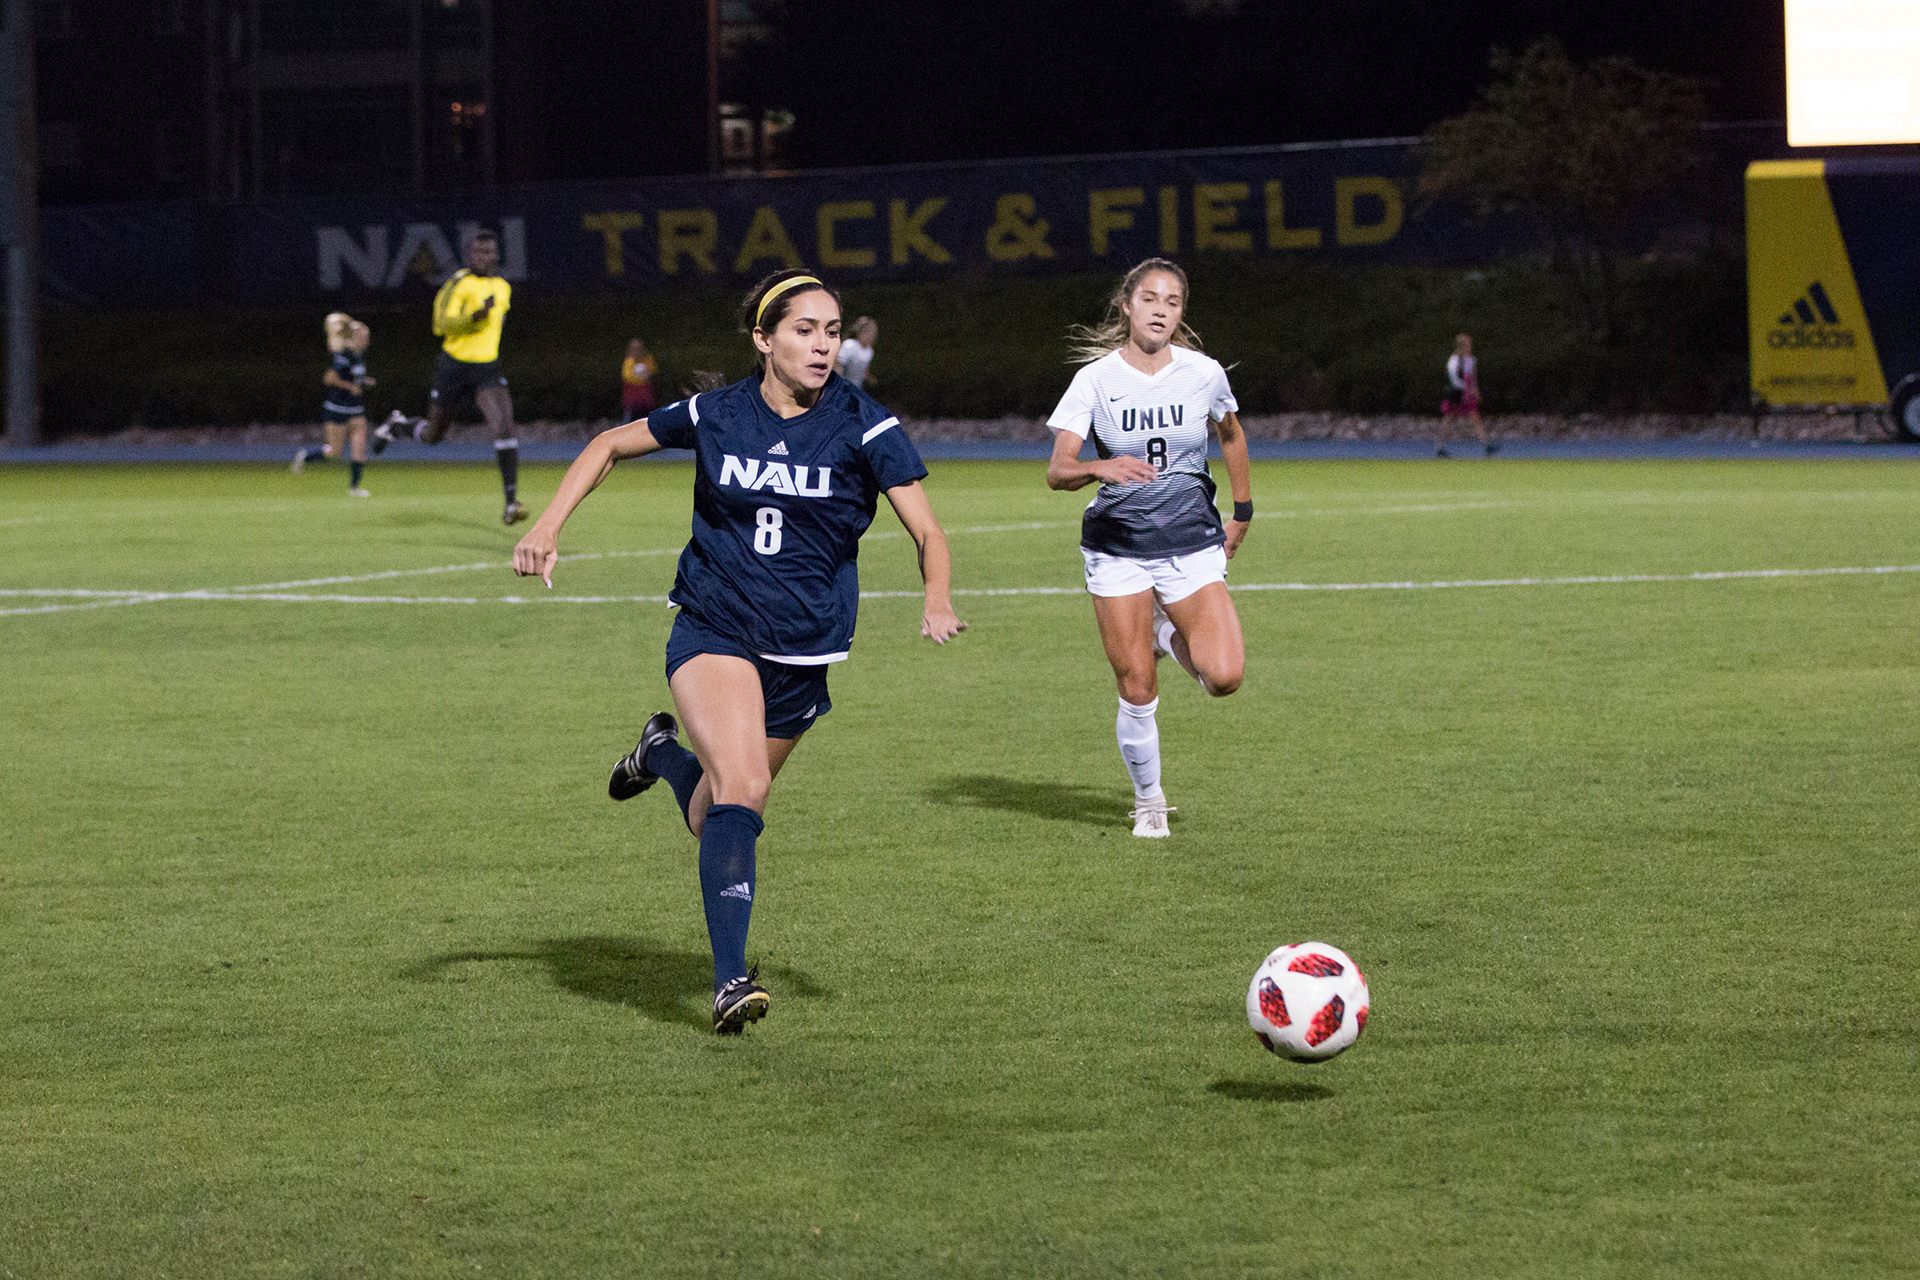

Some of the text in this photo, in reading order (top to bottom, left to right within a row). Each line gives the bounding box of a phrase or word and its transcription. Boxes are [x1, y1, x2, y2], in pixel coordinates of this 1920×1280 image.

[582, 197, 952, 276] TRACK
[986, 193, 1055, 261] &
[1088, 176, 1404, 256] FIELD
[1767, 326, 1855, 349] adidas
[1122, 405, 1184, 432] UNLV
[1146, 437, 1168, 473] 8
[719, 453, 832, 498] NAU
[754, 506, 783, 556] 8
[720, 889, 751, 901] adidas
